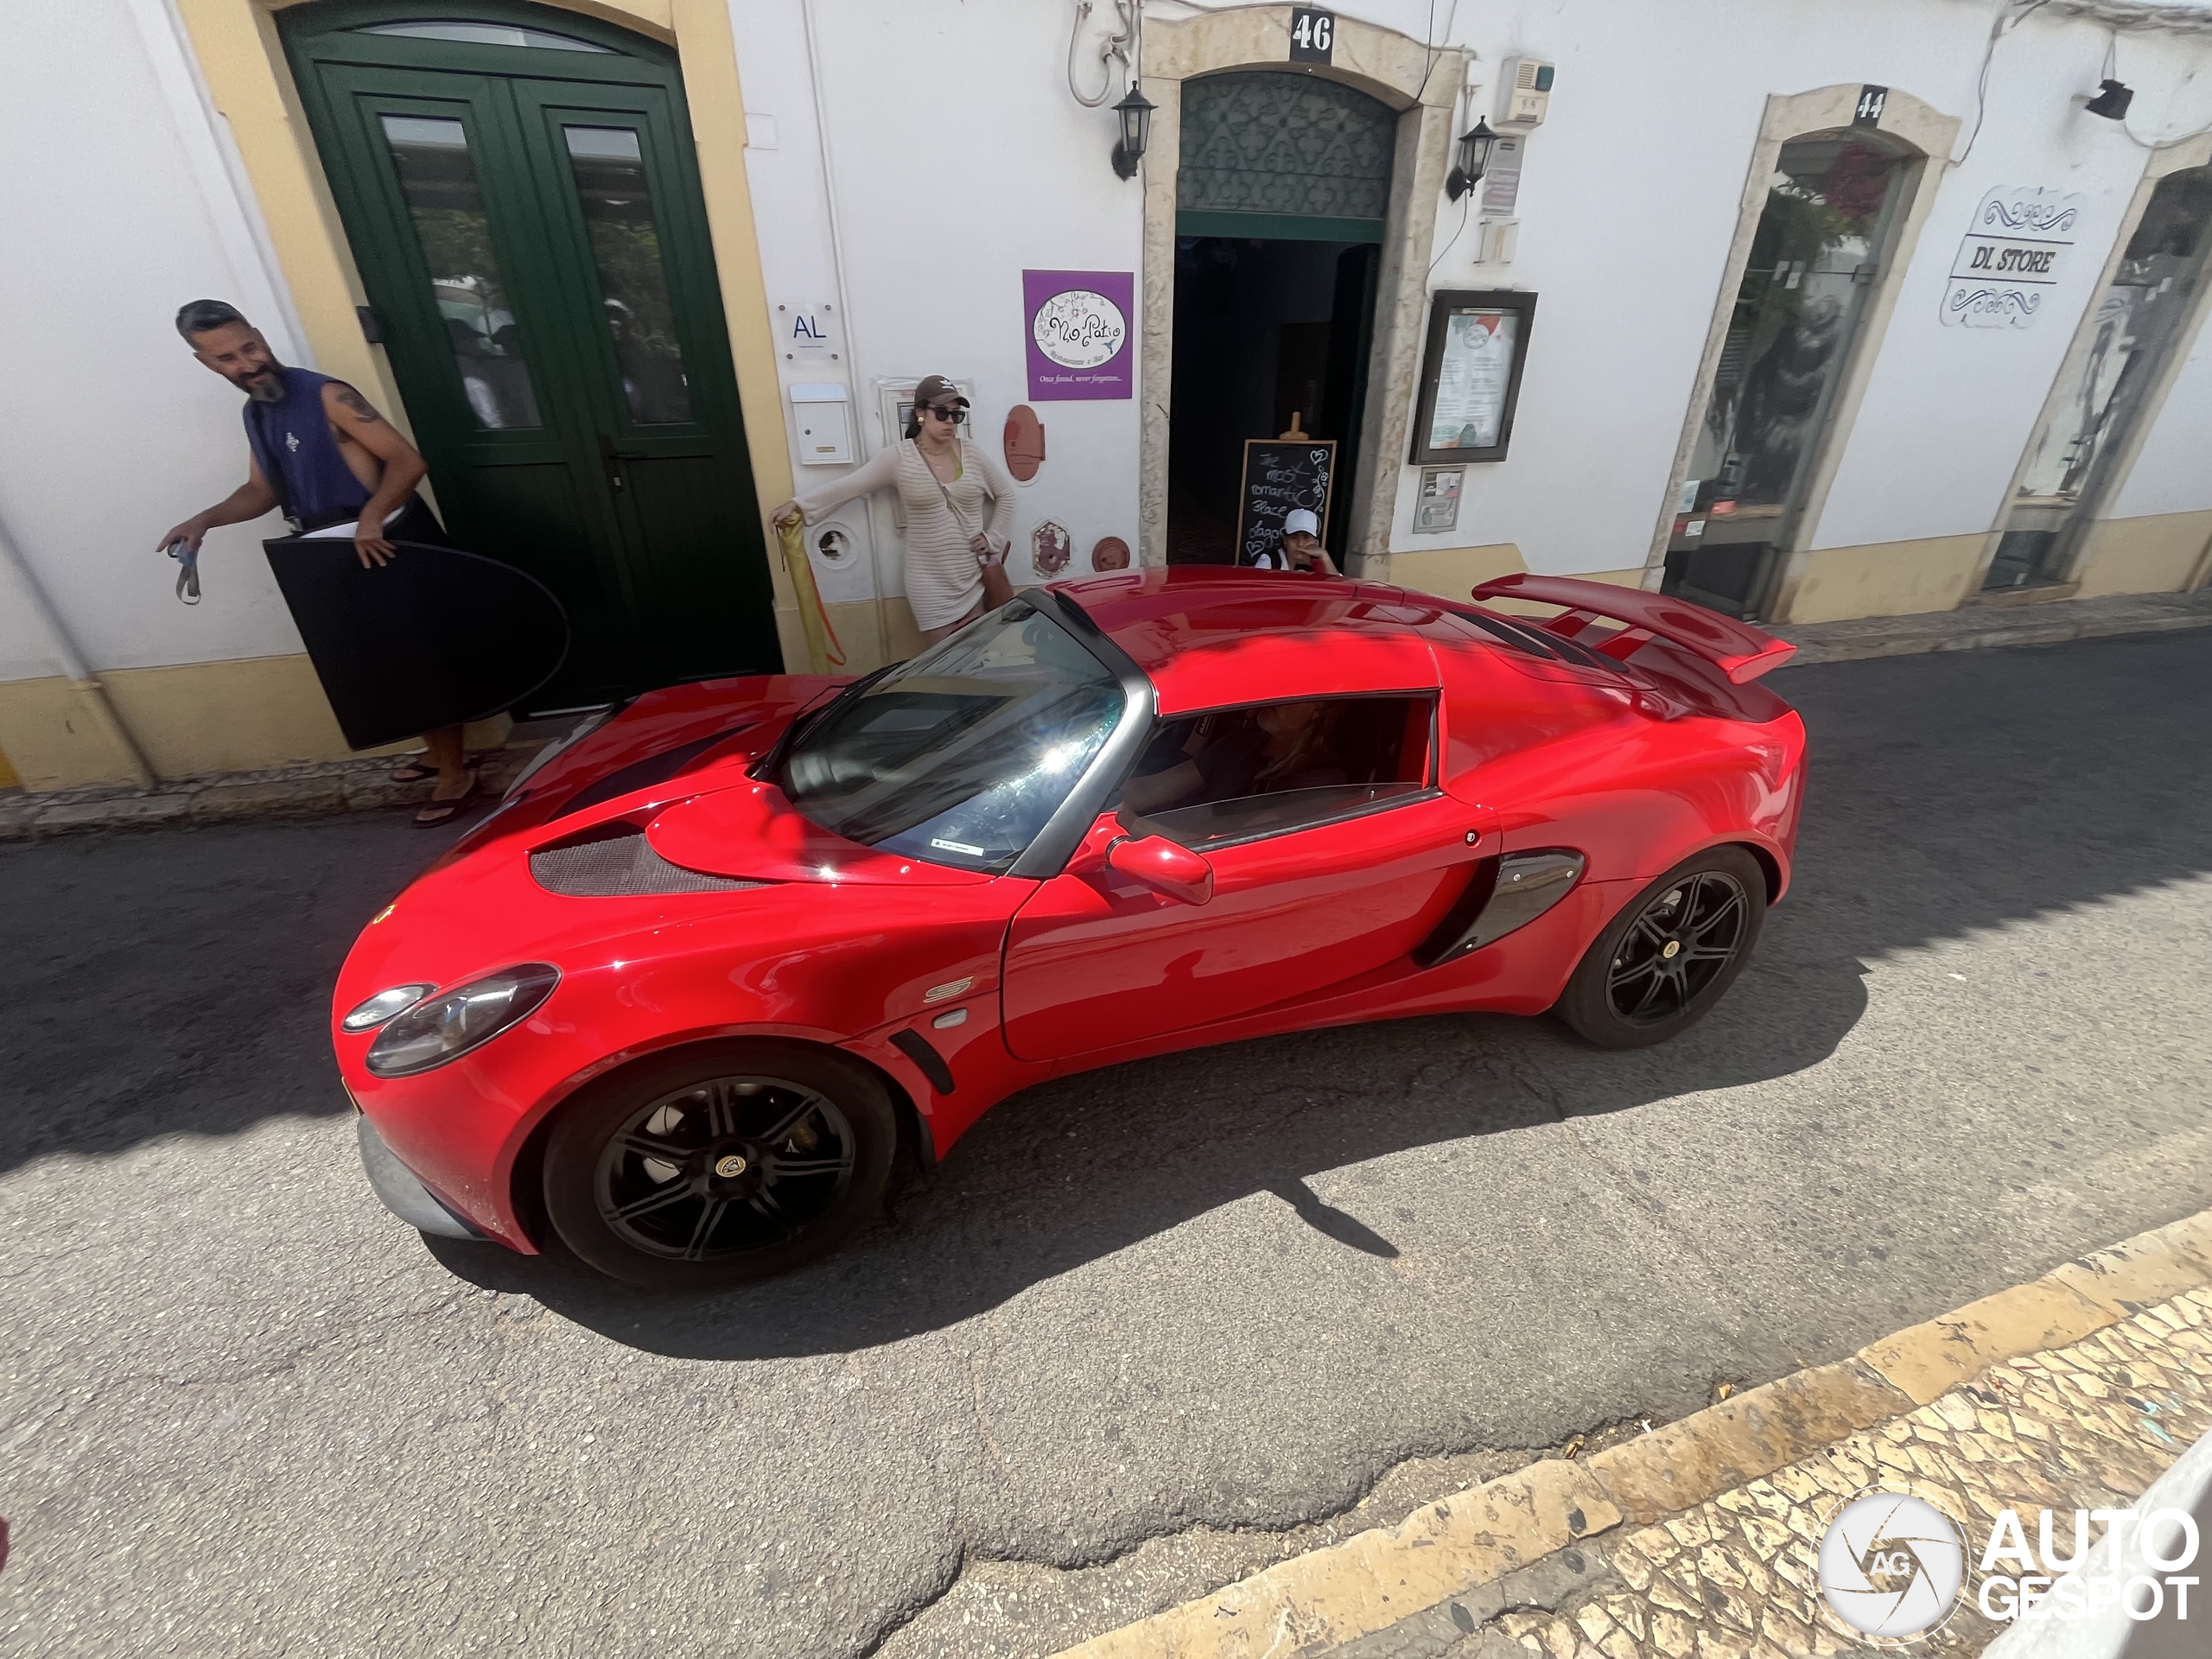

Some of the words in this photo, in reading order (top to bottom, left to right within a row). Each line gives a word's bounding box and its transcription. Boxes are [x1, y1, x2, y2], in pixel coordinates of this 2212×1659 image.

[1293, 15, 1331, 50] 46
[1858, 92, 1884, 118] 44
[1970, 245, 1995, 270] DL
[1997, 248, 2056, 273] STORE
[793, 315, 827, 338] AL
[1049, 316, 1080, 342] No
[1082, 314, 1121, 347] Patio
